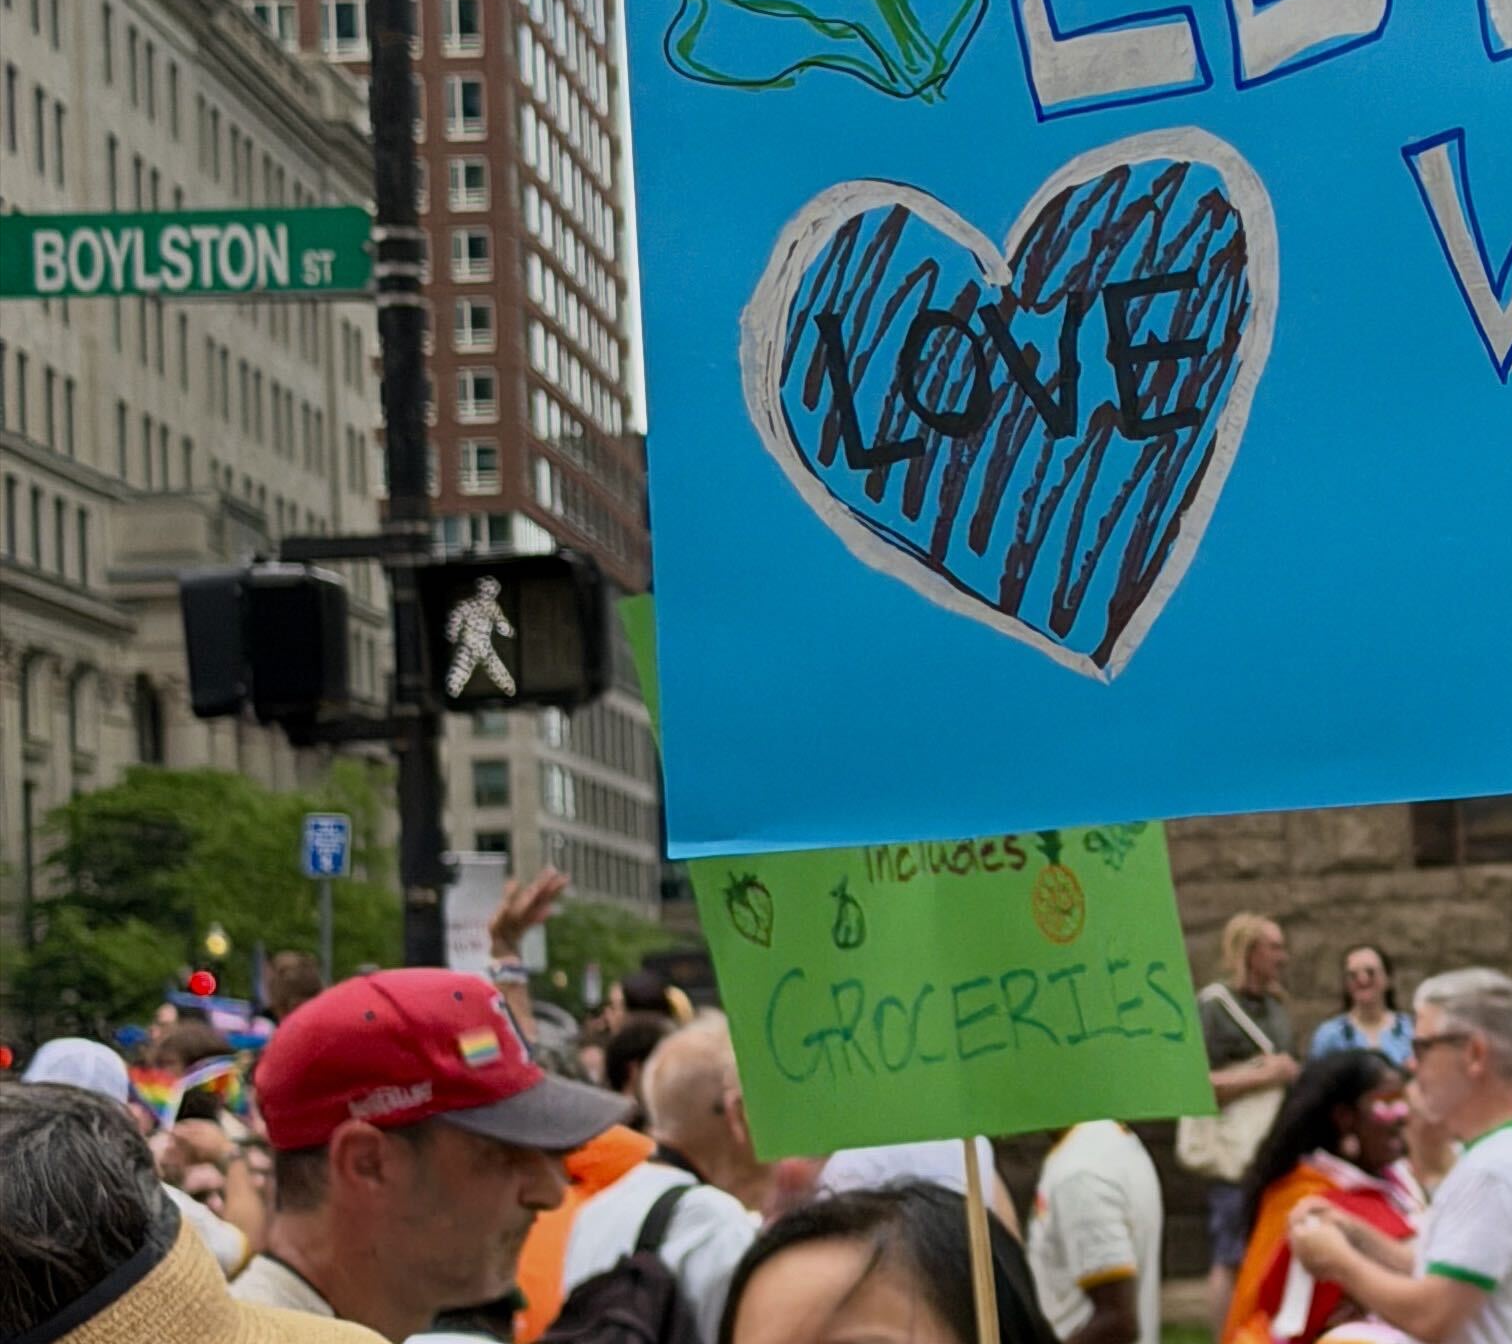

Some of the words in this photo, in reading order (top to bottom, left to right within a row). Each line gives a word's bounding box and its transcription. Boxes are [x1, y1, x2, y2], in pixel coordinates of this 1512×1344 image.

[32, 222, 290, 293] BOYLSTON
[302, 249, 336, 286] ST
[815, 268, 1207, 469] LOVE
[766, 959, 1187, 1083] GROCERIES
